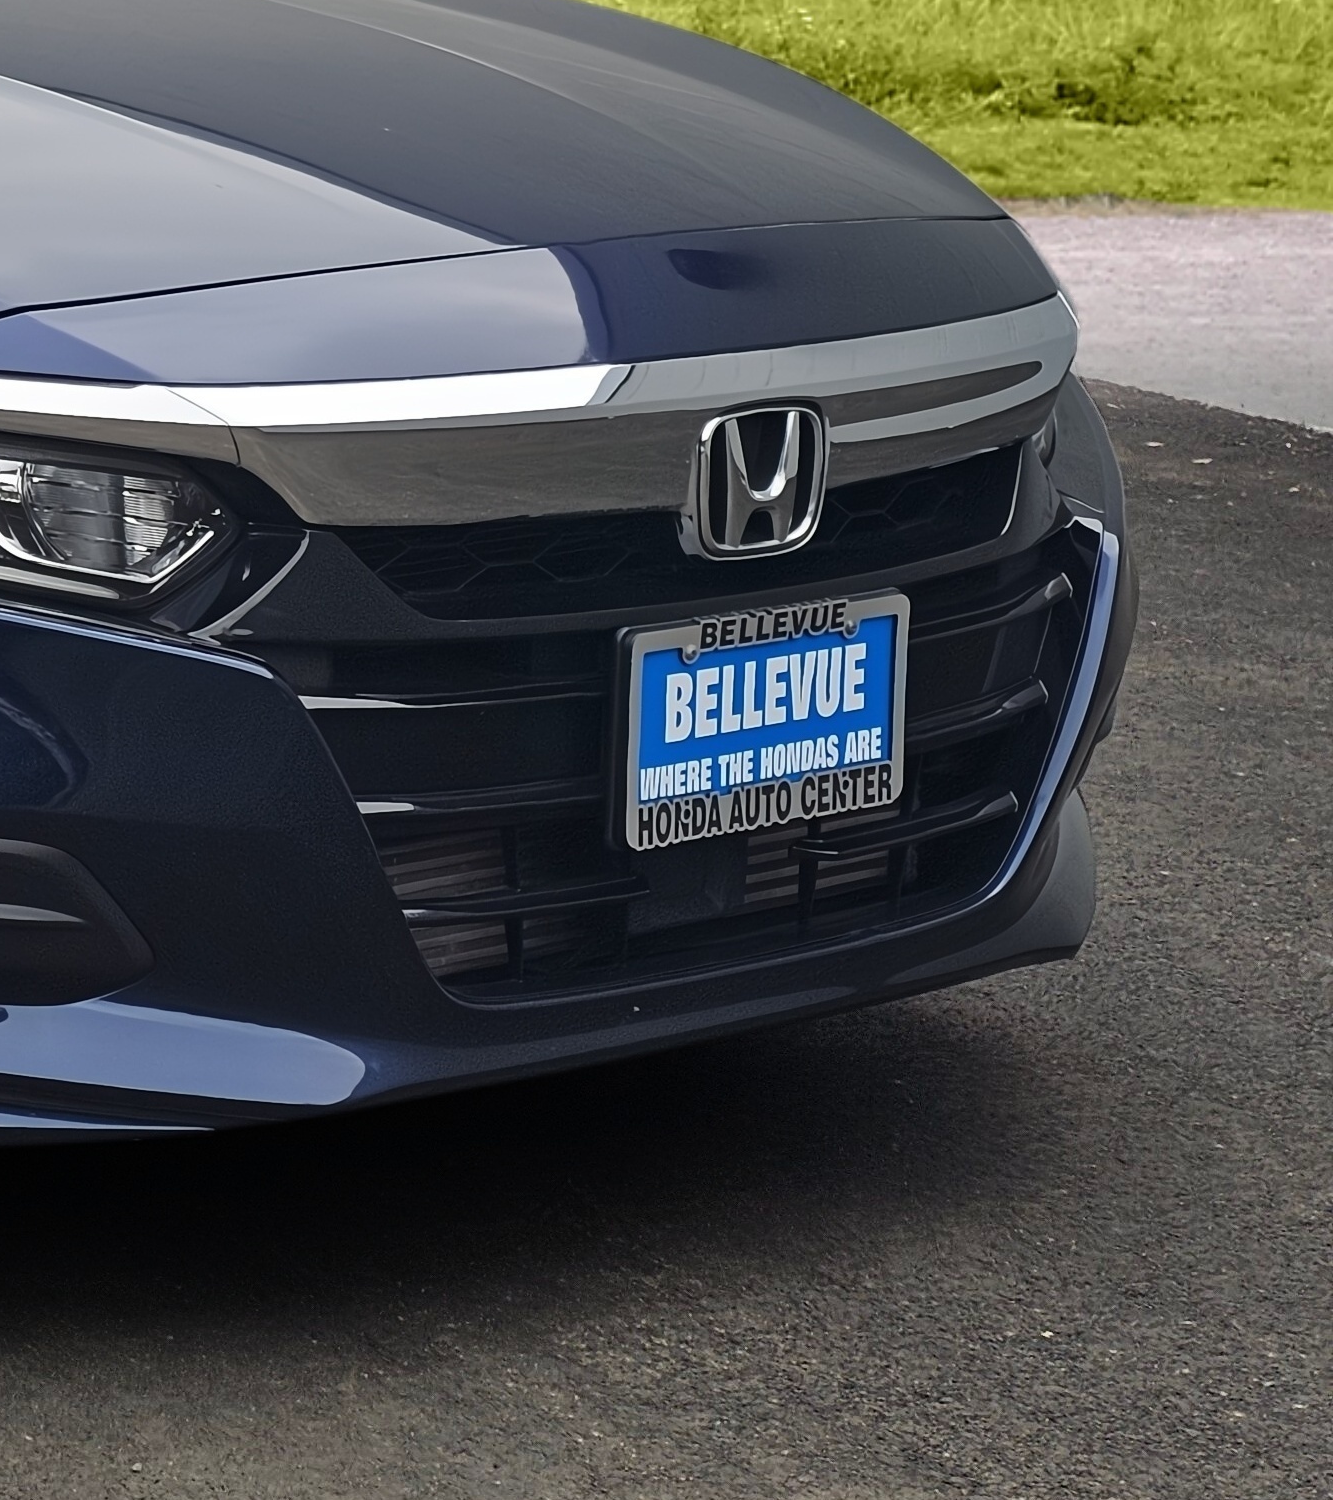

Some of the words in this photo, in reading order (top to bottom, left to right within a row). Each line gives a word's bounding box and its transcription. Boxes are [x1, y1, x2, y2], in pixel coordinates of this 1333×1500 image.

[700, 601, 847, 648] BELLEVUE
[664, 643, 867, 743] BELLEVUE
[639, 758, 712, 801] WHERE
[718, 750, 754, 786] THE
[760, 734, 839, 779] HONDAS
[844, 726, 882, 764] ARE
[637, 793, 722, 847] HONDA
[729, 781, 791, 832] AUTO
[801, 764, 893, 812] CENTER
